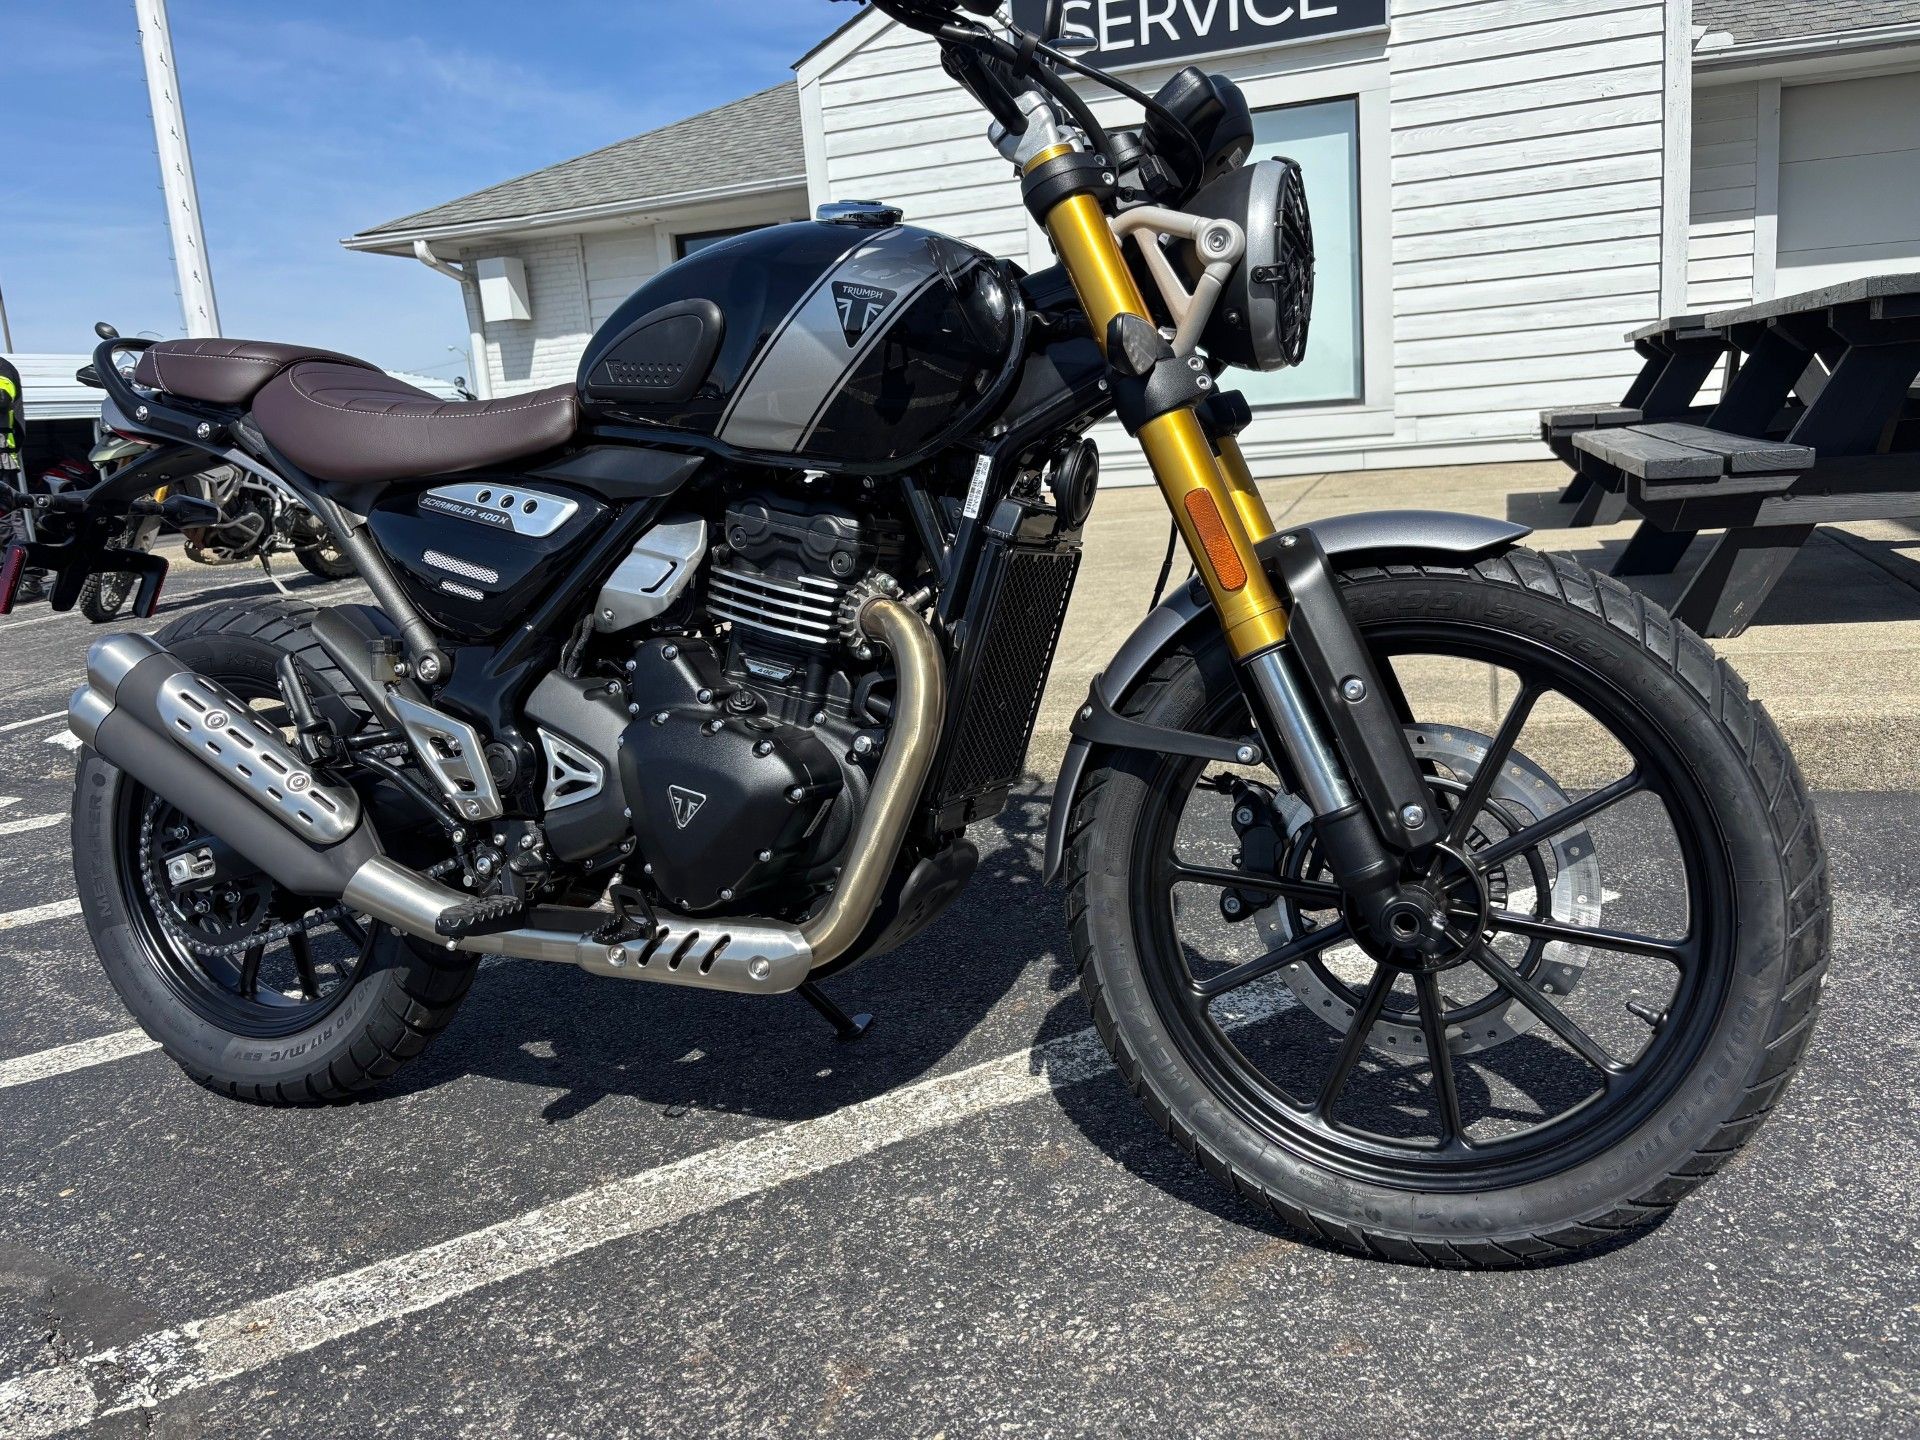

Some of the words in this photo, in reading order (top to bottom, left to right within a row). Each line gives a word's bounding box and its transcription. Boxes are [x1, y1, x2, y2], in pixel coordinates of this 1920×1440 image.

[842, 285, 884, 300] TRIUMPH
[421, 497, 477, 517] SCRAMBLER
[478, 511, 500, 523] 400
[1484, 603, 1619, 661] STREET
[88, 794, 112, 918] METZELER
